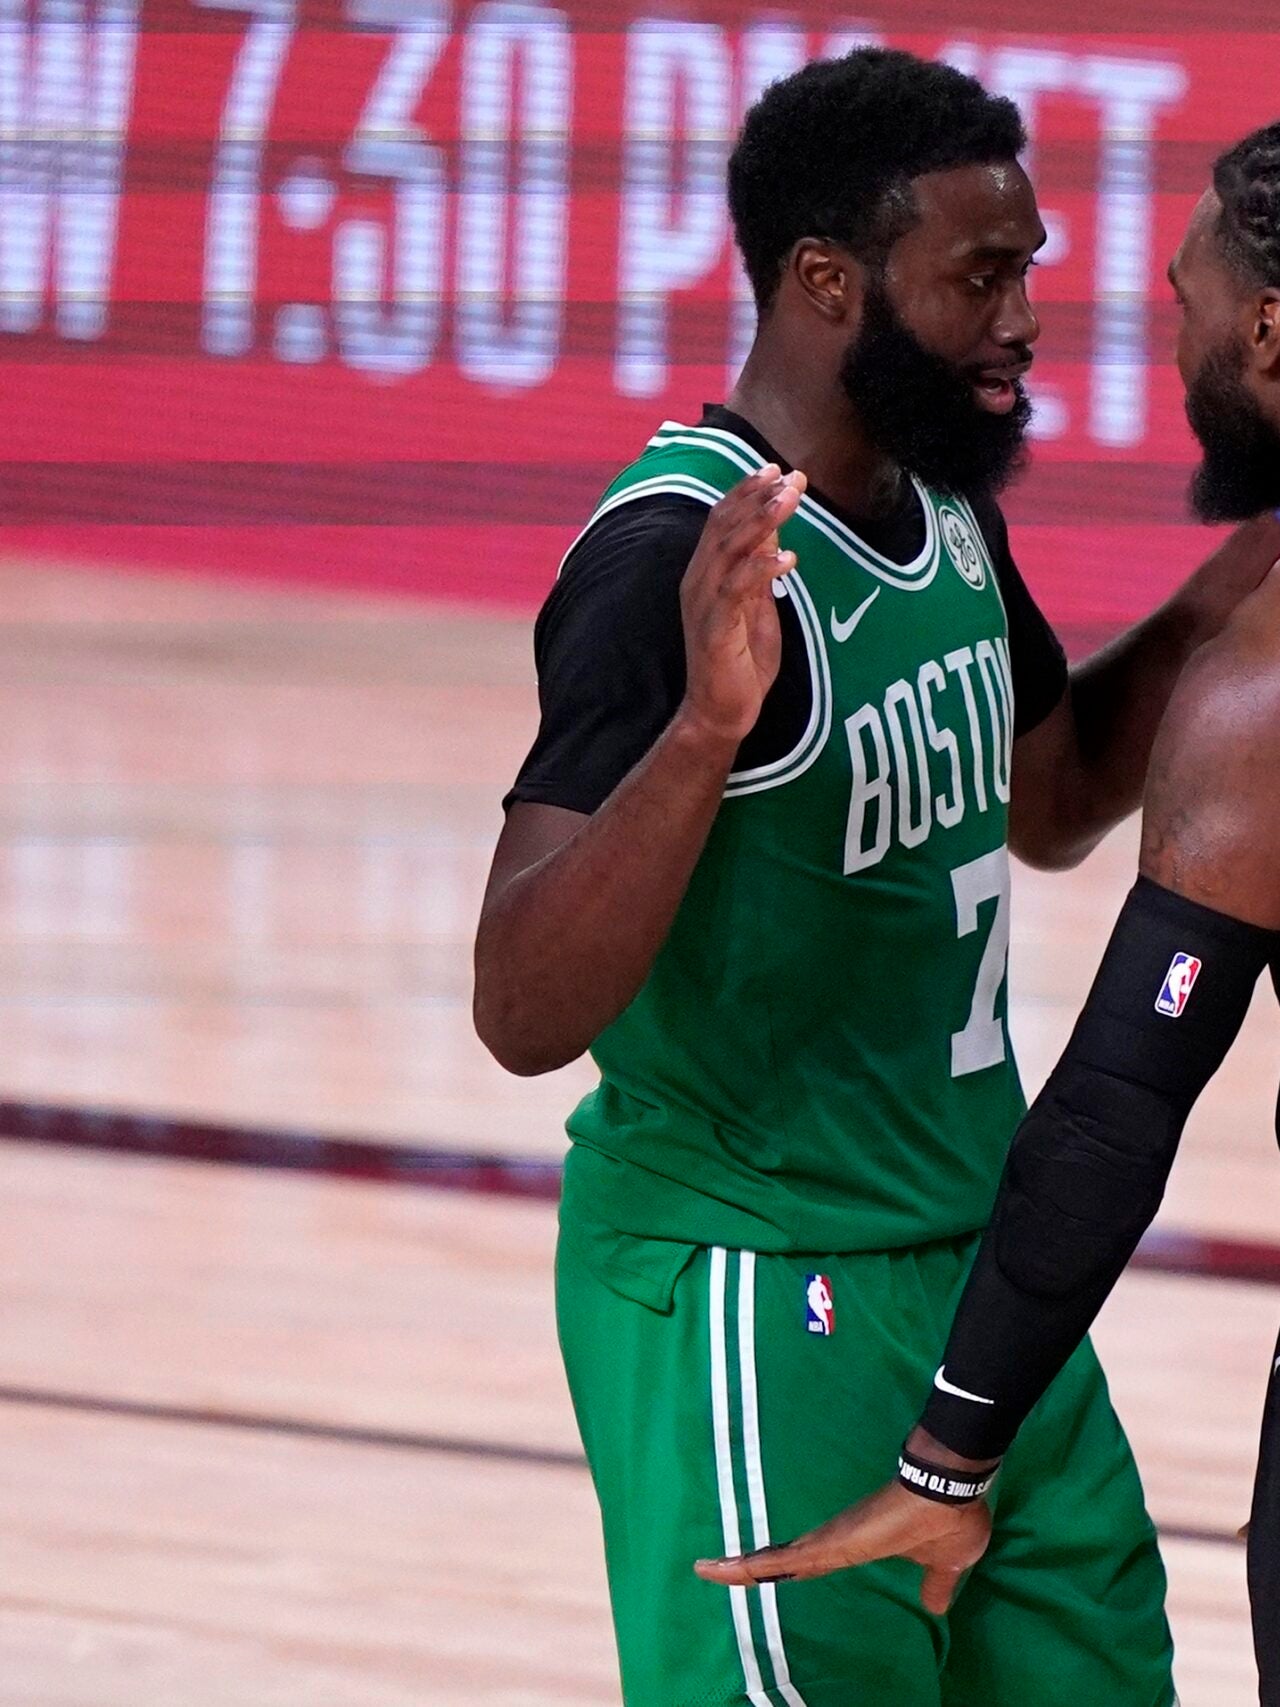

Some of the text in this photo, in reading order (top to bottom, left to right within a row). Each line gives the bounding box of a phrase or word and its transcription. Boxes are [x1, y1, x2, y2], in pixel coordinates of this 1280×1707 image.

[203, 0, 576, 388] 7:30
[949, 842, 1012, 1079] 7
[900, 1462, 929, 1487] PRAY
[927, 1474, 947, 1494] TO
[946, 1480, 977, 1497] TIME
